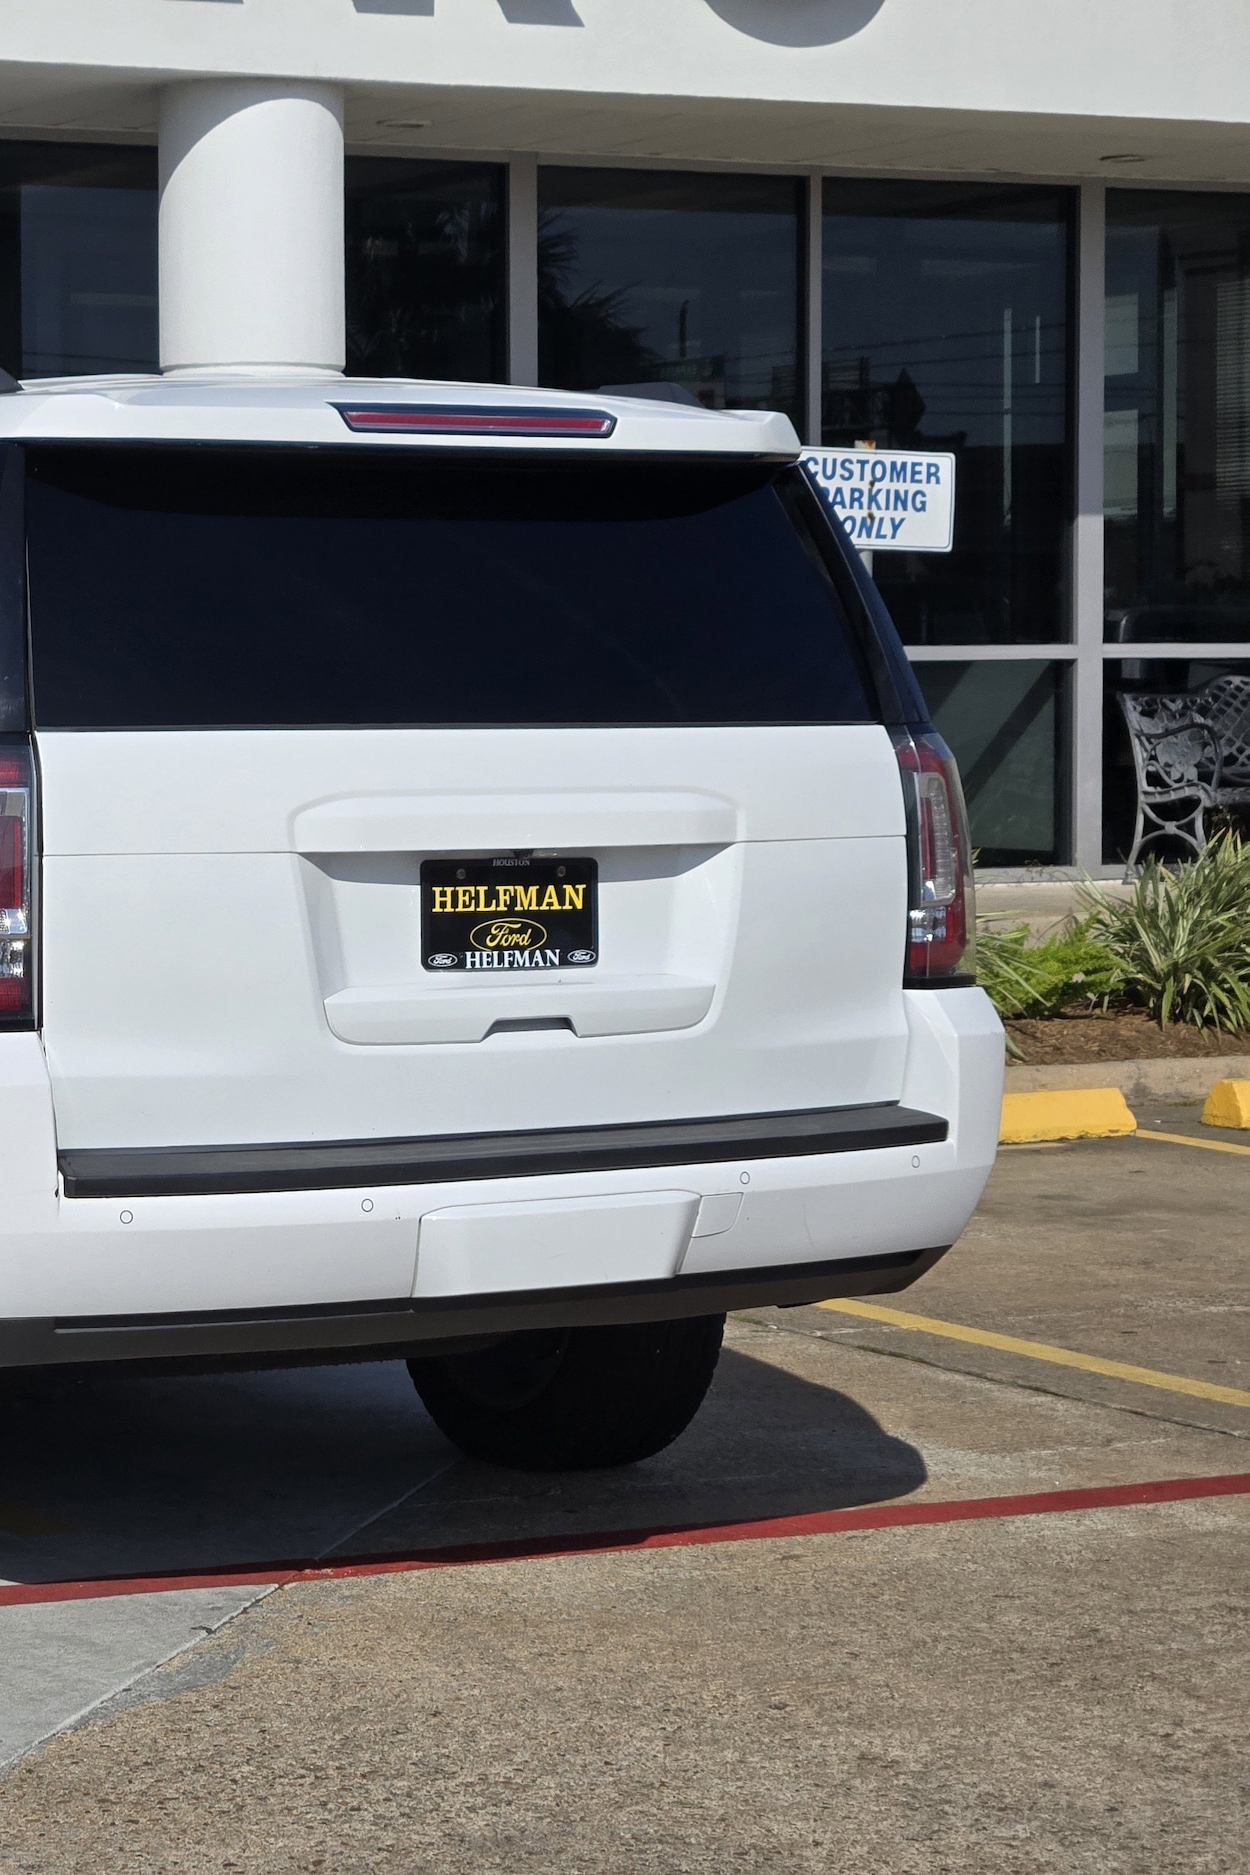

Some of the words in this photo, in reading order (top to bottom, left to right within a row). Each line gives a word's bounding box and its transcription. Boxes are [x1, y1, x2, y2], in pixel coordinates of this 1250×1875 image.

[805, 457, 941, 485] CUSTOMER
[822, 486, 927, 512] ARKING
[843, 515, 907, 540] ONLY
[493, 858, 530, 867] HOUSTON
[432, 884, 586, 913] HELFMAN
[485, 922, 532, 947] Ford
[465, 949, 561, 969] HELFMAN
